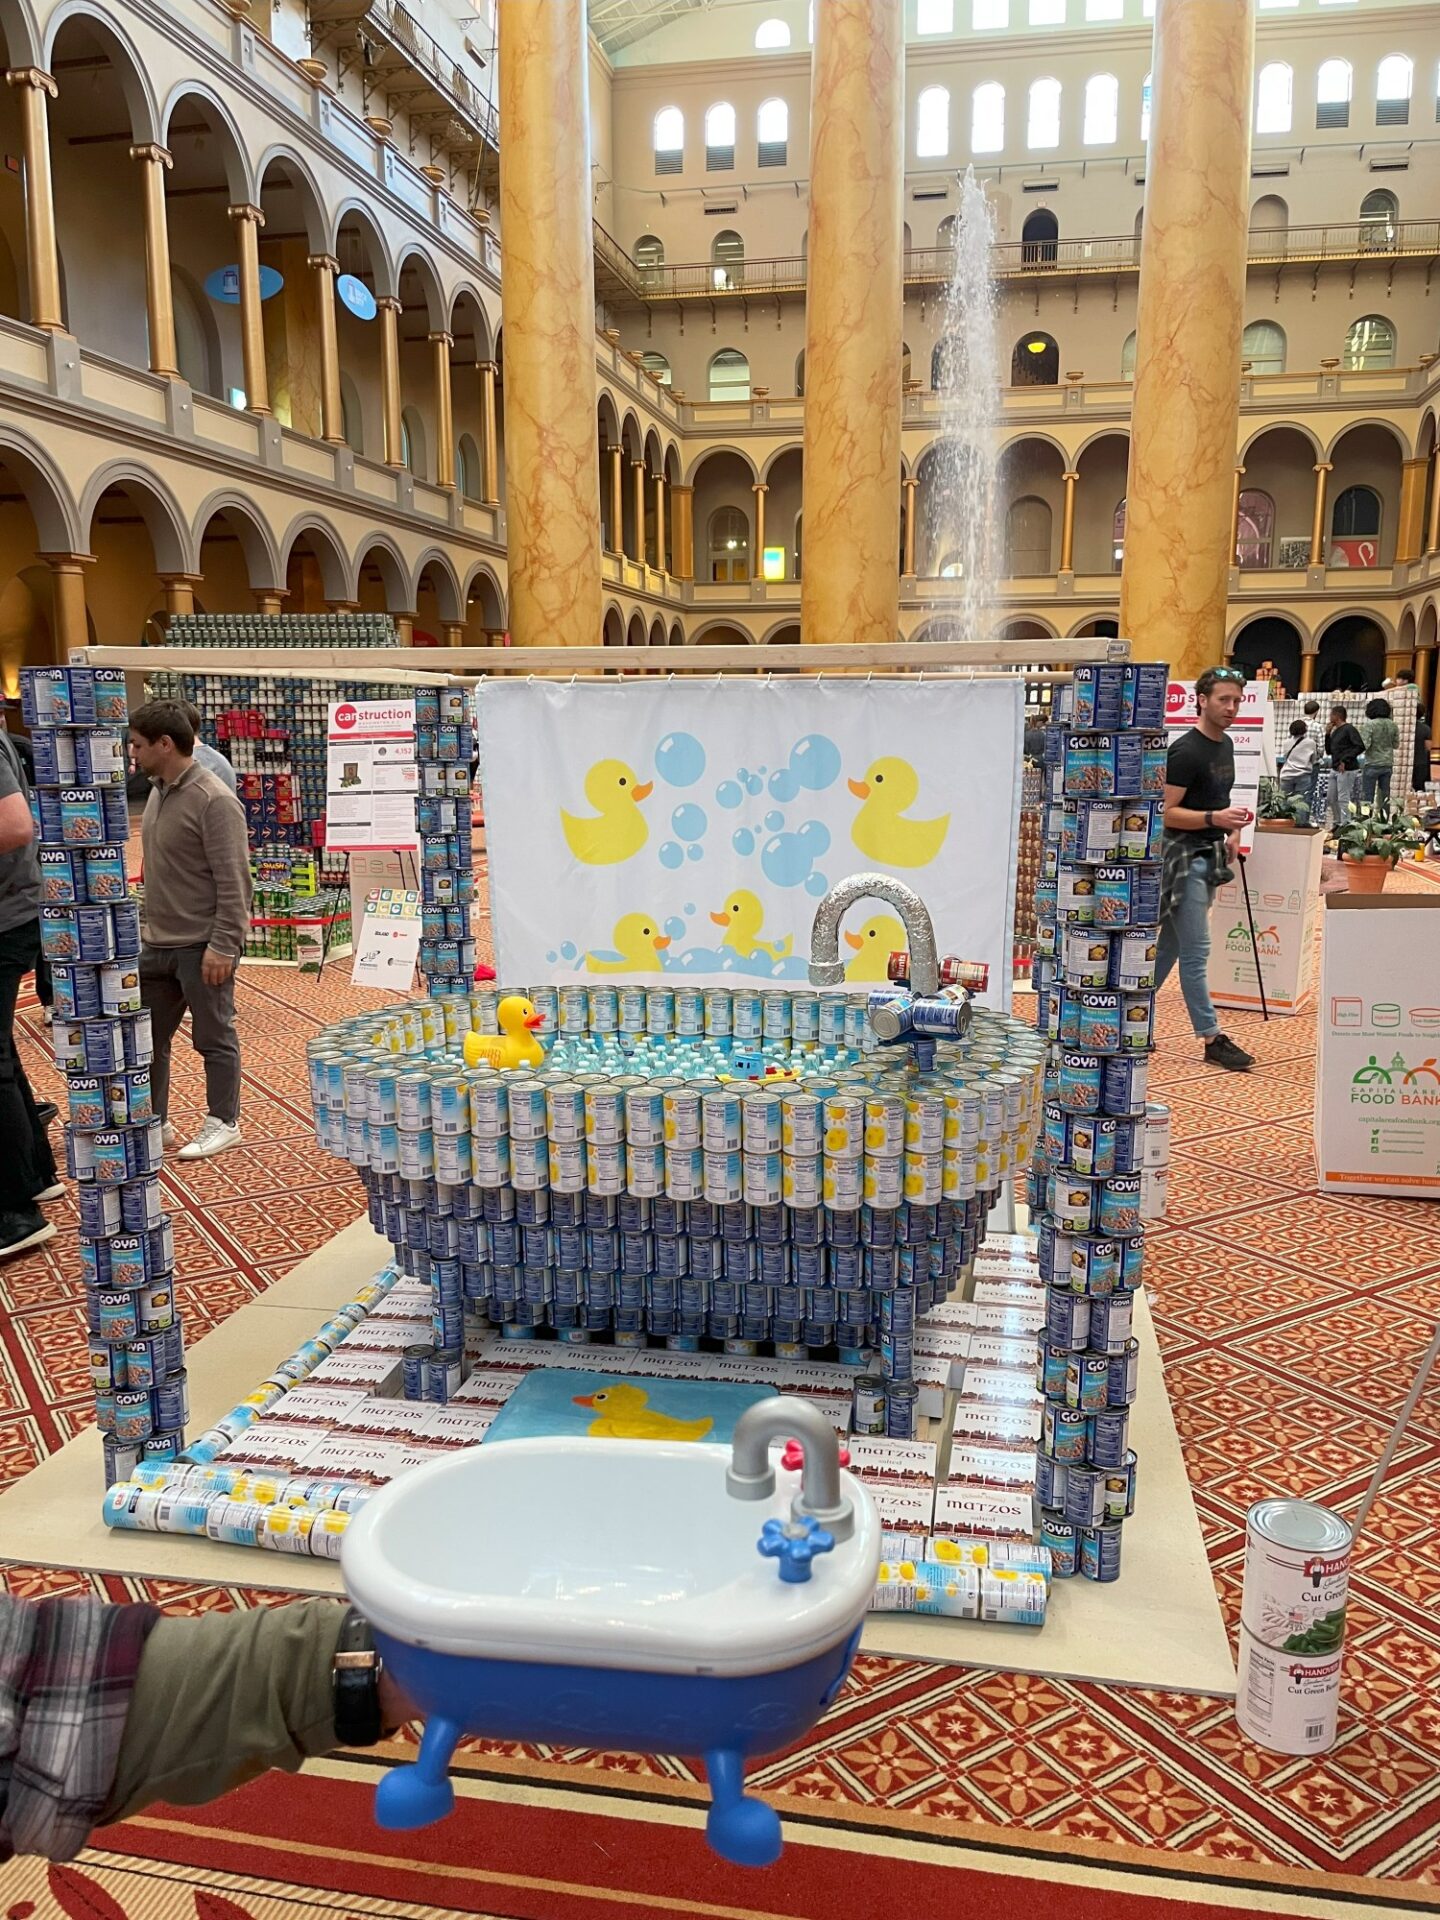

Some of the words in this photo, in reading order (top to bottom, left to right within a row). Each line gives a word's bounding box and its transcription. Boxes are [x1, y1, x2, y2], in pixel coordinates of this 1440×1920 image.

[50, 670, 63, 680] YA
[95, 670, 125, 683] GOYA
[1078, 668, 1091, 680] YA
[337, 709, 412, 722] canstruction
[61, 790, 95, 801] GOYA
[1063, 801, 1076, 812] YA
[40, 851, 65, 862] OYA
[86, 848, 117, 860] GOYA
[1036, 881, 1056, 889] GOYA
[1072, 929, 1088, 937] GOYA
[1225, 944, 1251, 953] FOOD
[1082, 994, 1117, 1007] GOYA
[1064, 1054, 1098, 1067] GOYA
[68, 1078, 98, 1090] GOYA
[1351, 1093, 1395, 1105] FOOD
[1046, 1107, 1061, 1120] YA
[1102, 1120, 1116, 1132] GO
[1340, 1173, 1372, 1183] Together
[1401, 1176, 1420, 1184] solve
[1106, 1179, 1140, 1192] GOYA
[80, 1237, 91, 1246] YA
[1130, 1237, 1144, 1249] GO
[1095, 1244, 1112, 1255] GO
[100, 1293, 131, 1305] GOYA
[387, 1300, 432, 1308] matzo
[116, 1391, 148, 1405] GOYA
[858, 1388, 873, 1396] GOYA
[437, 1416, 492, 1429] matzo
[1041, 1519, 1073, 1536] GOYA
[1301, 1591, 1322, 1602] Cut
[1287, 1686, 1302, 1694] Cut
[1304, 1687, 1324, 1695] Green
